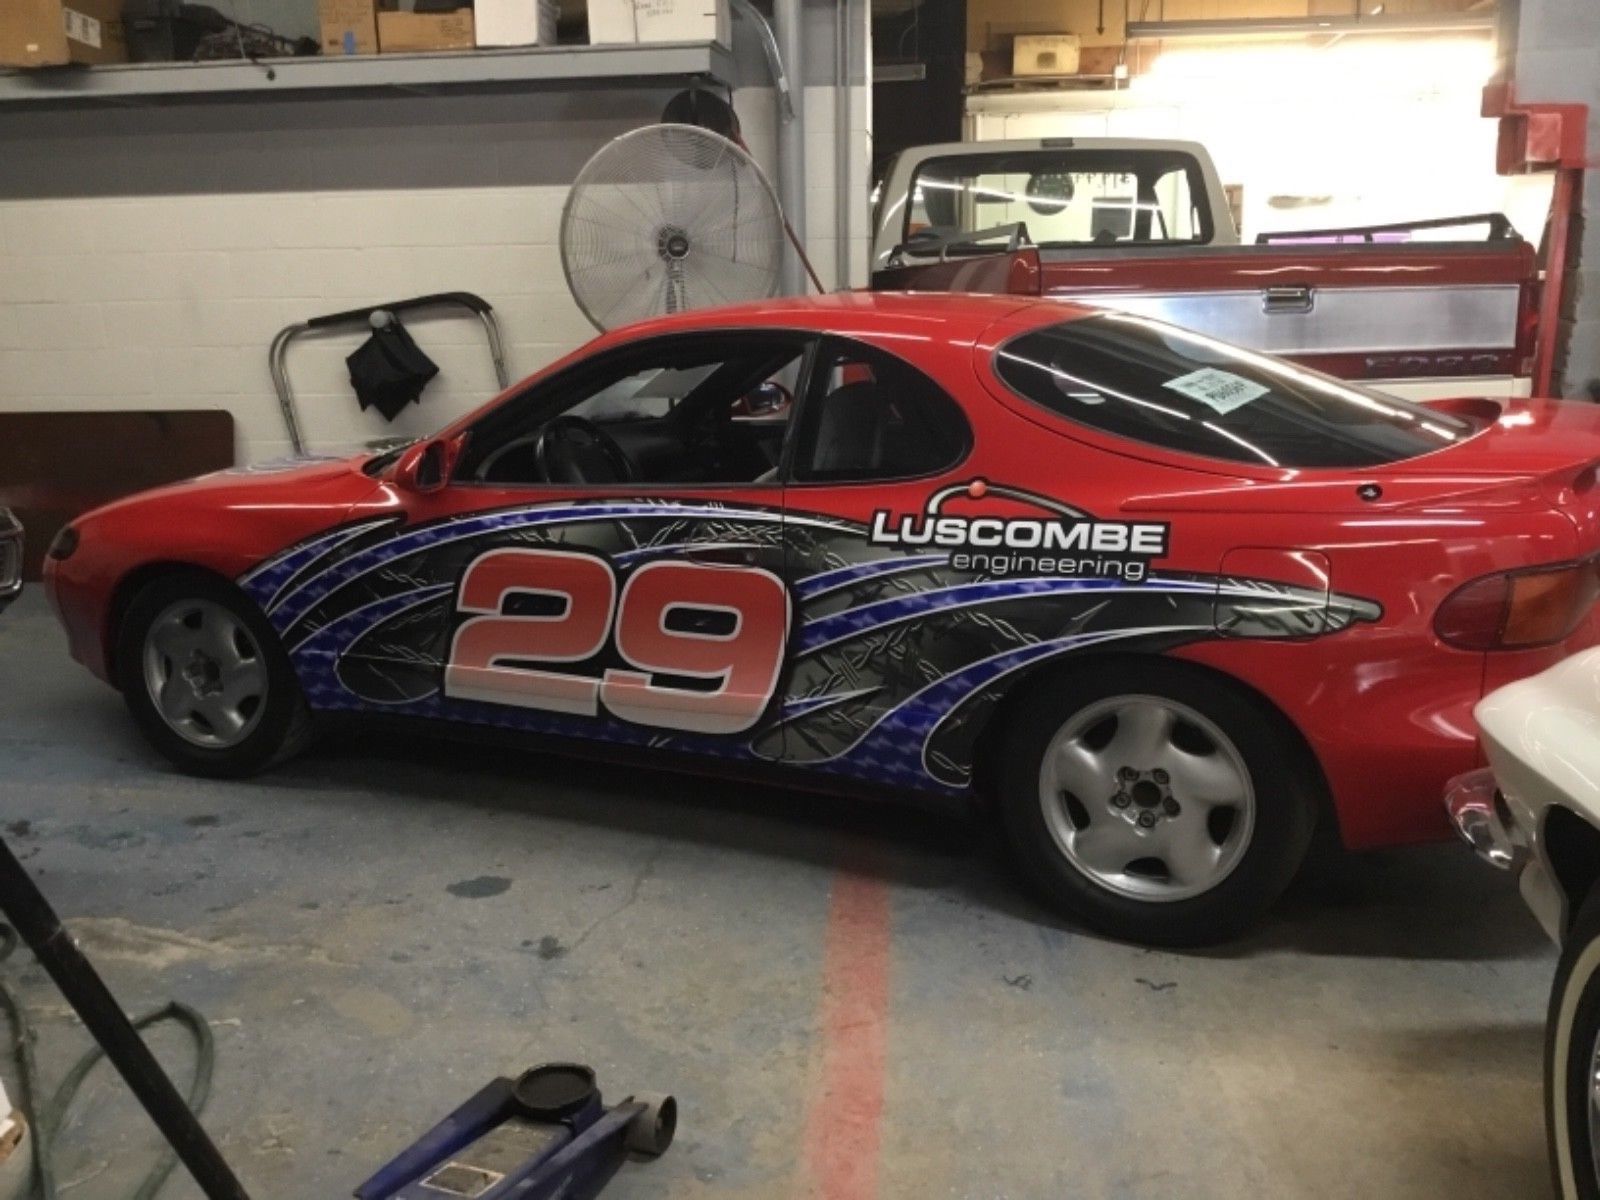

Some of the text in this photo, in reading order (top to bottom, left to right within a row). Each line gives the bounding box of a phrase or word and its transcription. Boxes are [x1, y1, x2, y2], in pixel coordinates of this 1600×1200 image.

[871, 511, 1166, 554] LUSCOMBE
[952, 551, 1146, 581] engineering
[444, 546, 793, 735] 29
